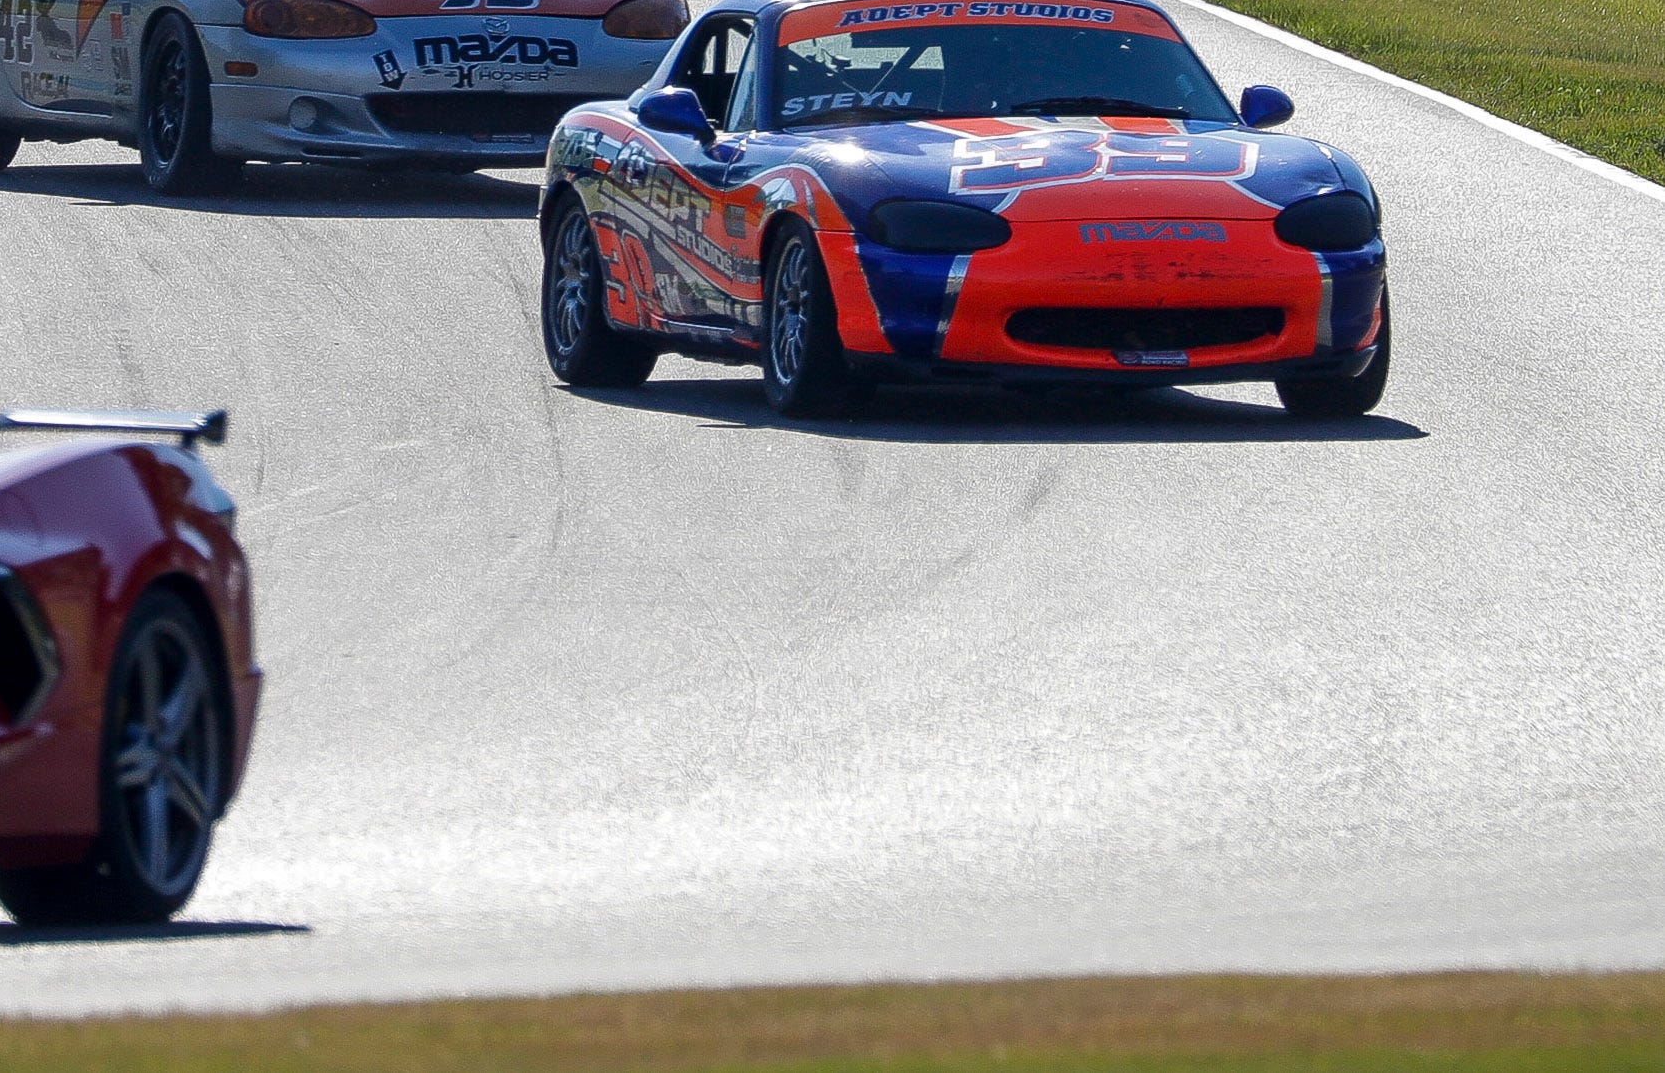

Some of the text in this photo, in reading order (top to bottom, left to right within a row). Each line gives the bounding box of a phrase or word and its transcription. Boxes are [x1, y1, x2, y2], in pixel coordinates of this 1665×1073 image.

[838, 1, 1115, 28] ADEPT STUDIOS
[479, 70, 549, 83] HOOSIER
[780, 92, 913, 116] STEYN
